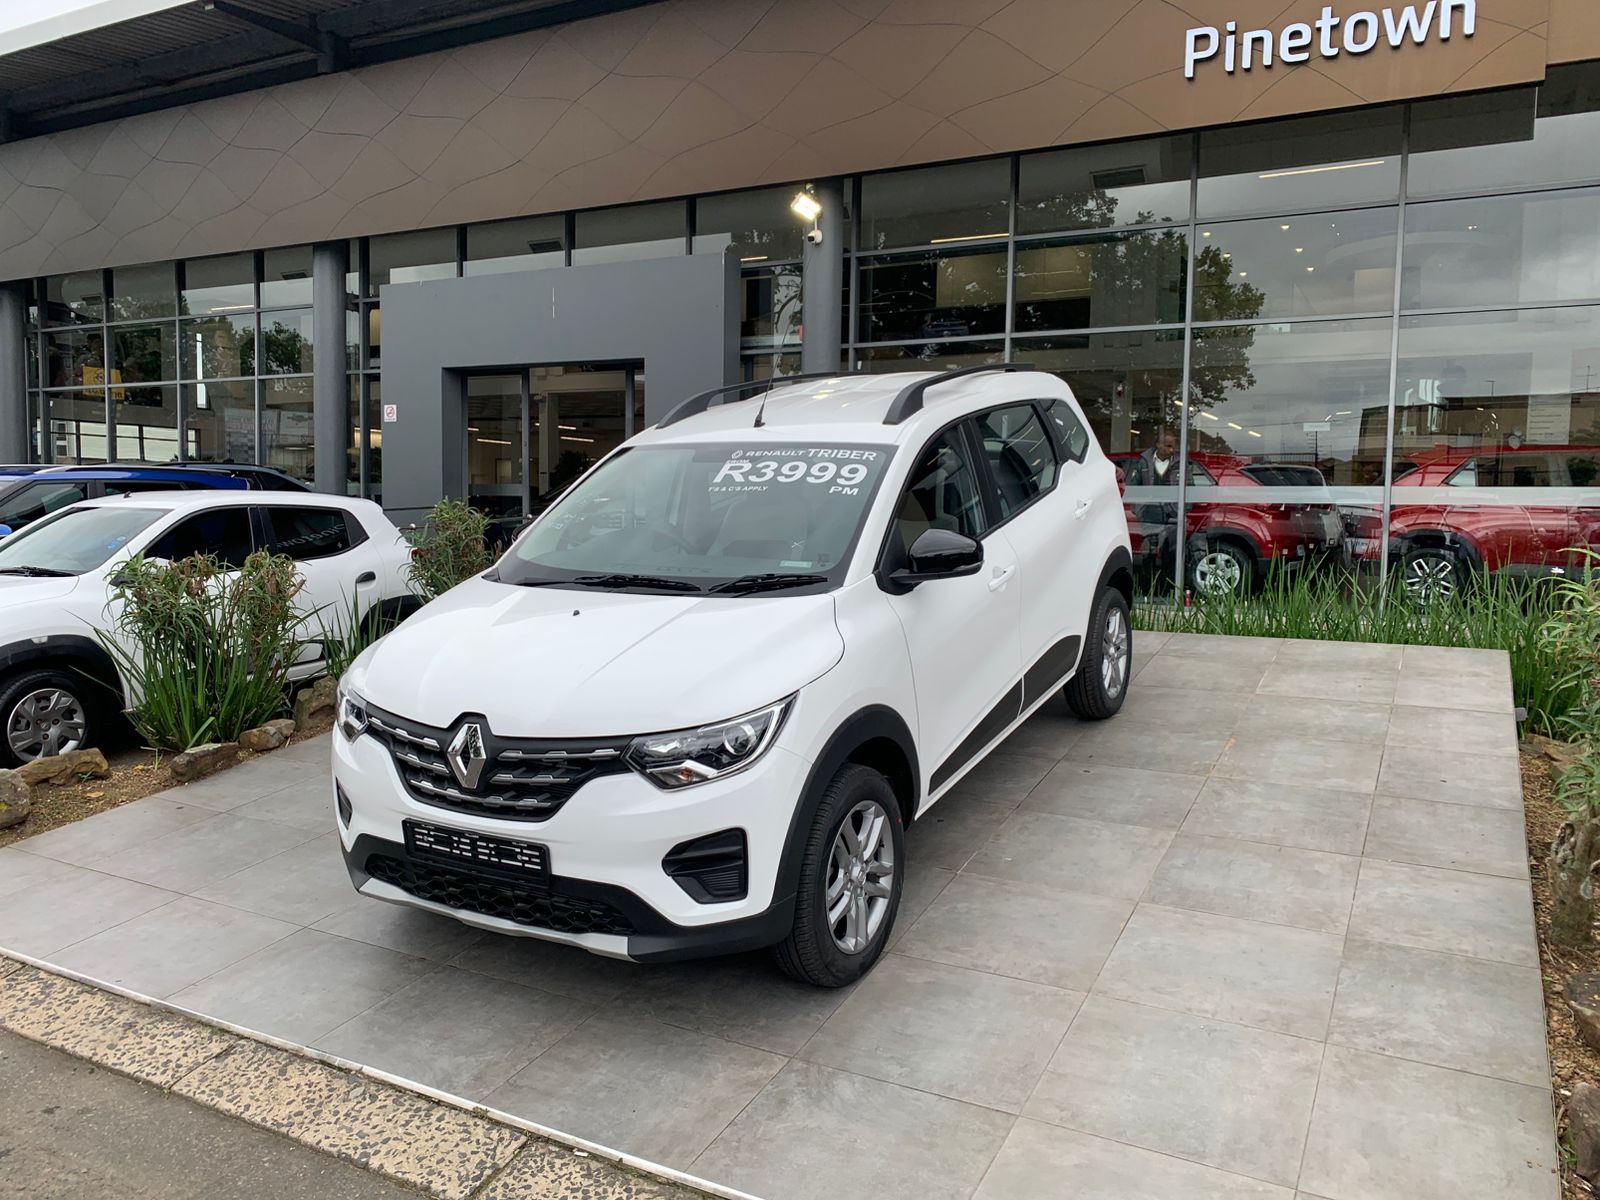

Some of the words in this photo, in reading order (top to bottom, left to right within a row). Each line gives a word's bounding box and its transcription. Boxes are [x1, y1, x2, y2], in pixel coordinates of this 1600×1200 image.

[1184, 0, 1477, 78] Pinetown
[745, 449, 807, 457] RENAULT
[807, 448, 877, 461] TRIBER
[712, 461, 868, 486] R3999
[829, 486, 859, 496] PM
